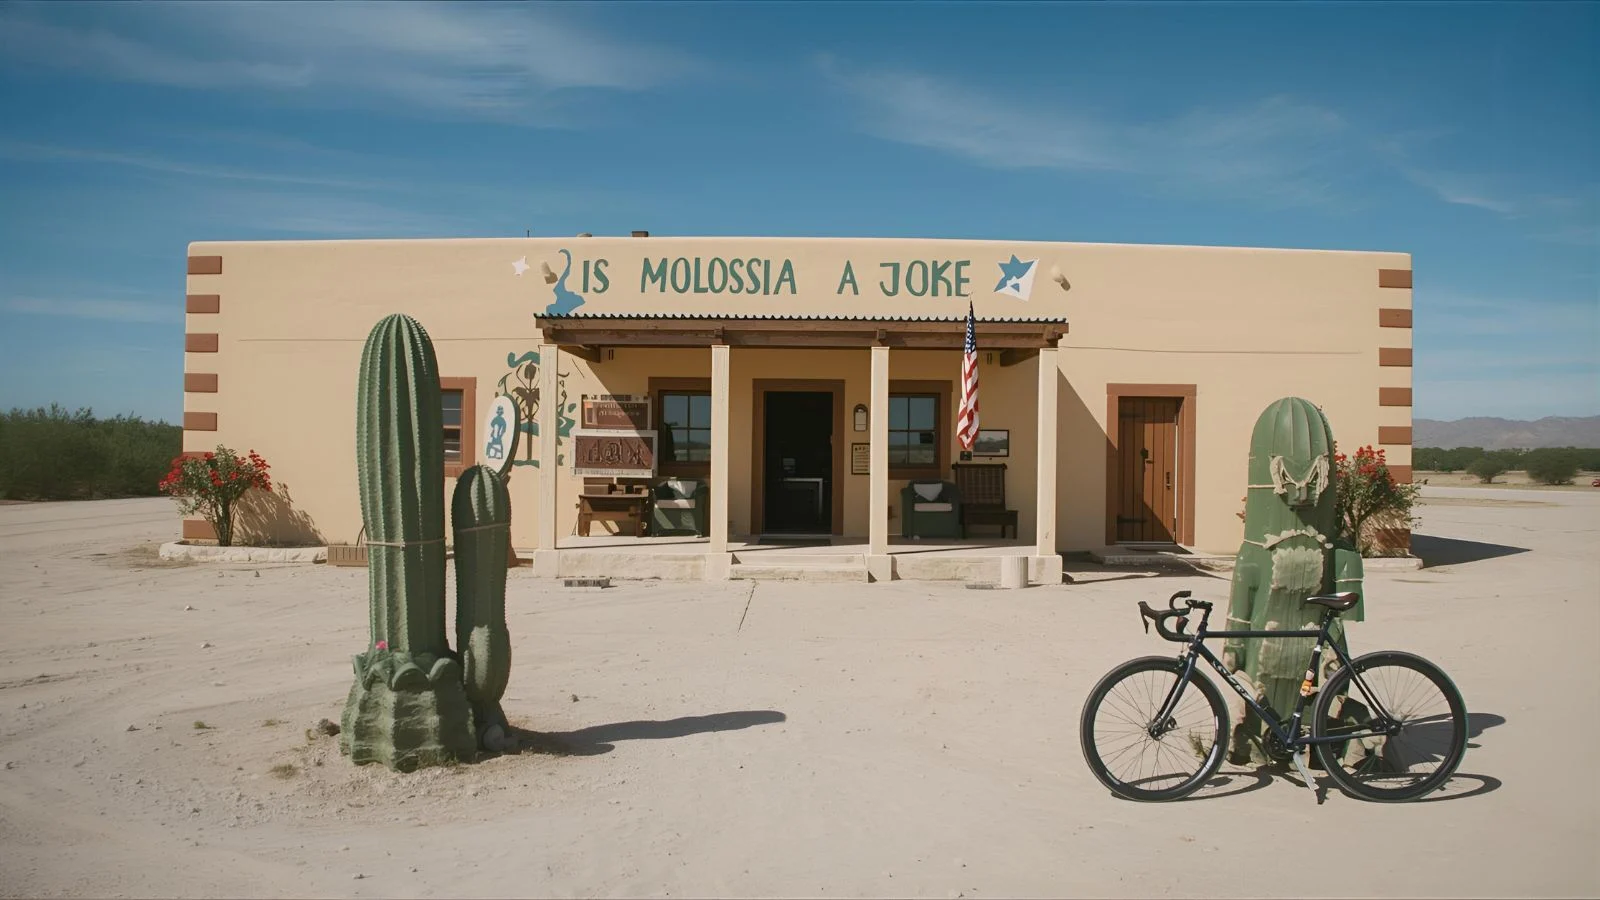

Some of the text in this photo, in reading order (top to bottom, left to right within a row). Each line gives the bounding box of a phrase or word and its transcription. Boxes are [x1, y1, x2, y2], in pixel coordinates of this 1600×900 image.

[582, 257, 971, 298] IS MOLOSSIA A JOKE
